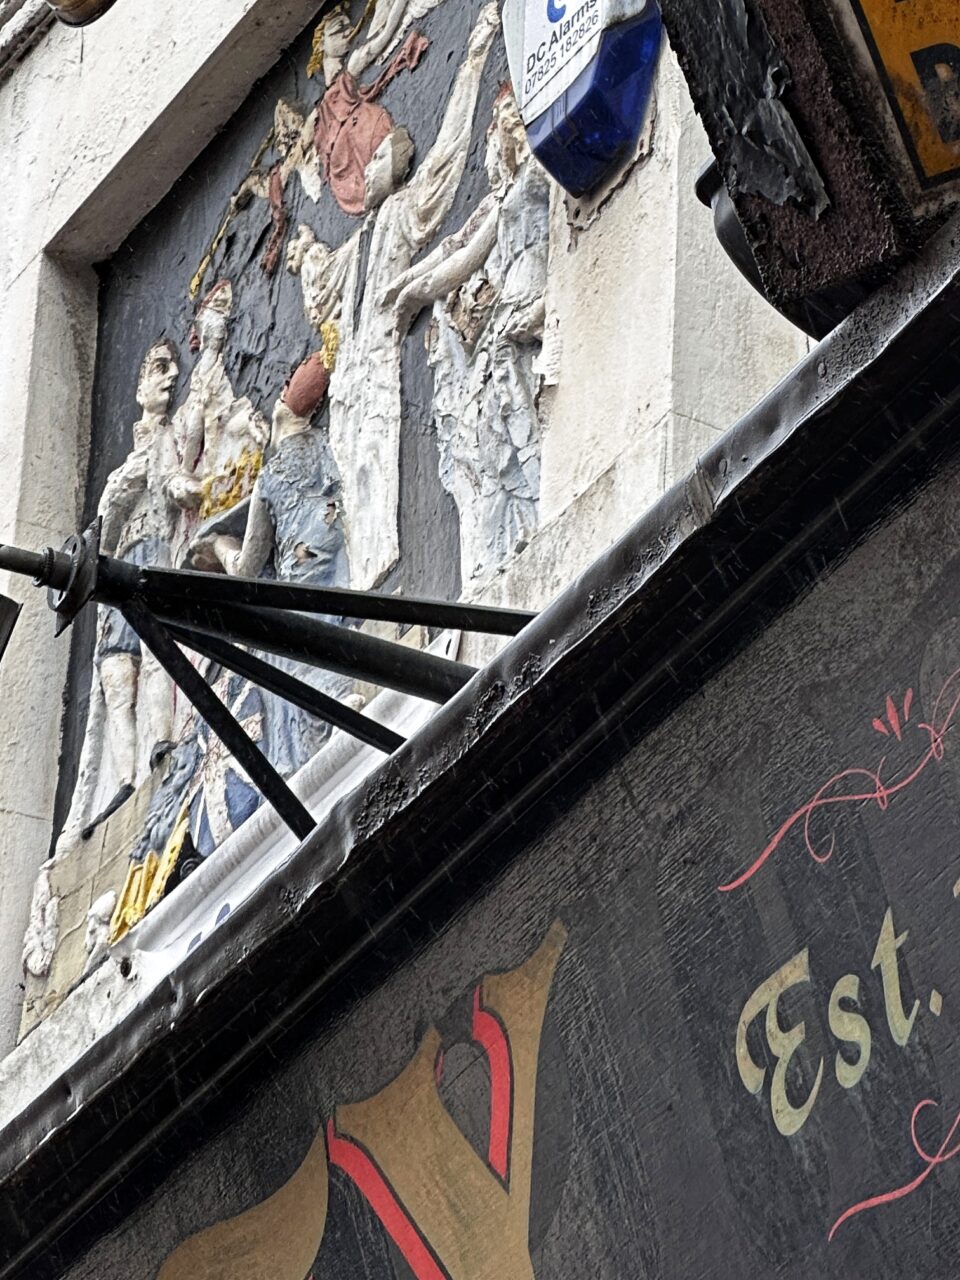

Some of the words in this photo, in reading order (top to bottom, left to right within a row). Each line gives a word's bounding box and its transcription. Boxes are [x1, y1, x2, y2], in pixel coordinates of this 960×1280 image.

[524, 51, 557, 95] 07825
[559, 9, 599, 58] 182826
[526, 41, 547, 75] DC
[735, 906, 943, 1137] Est.
